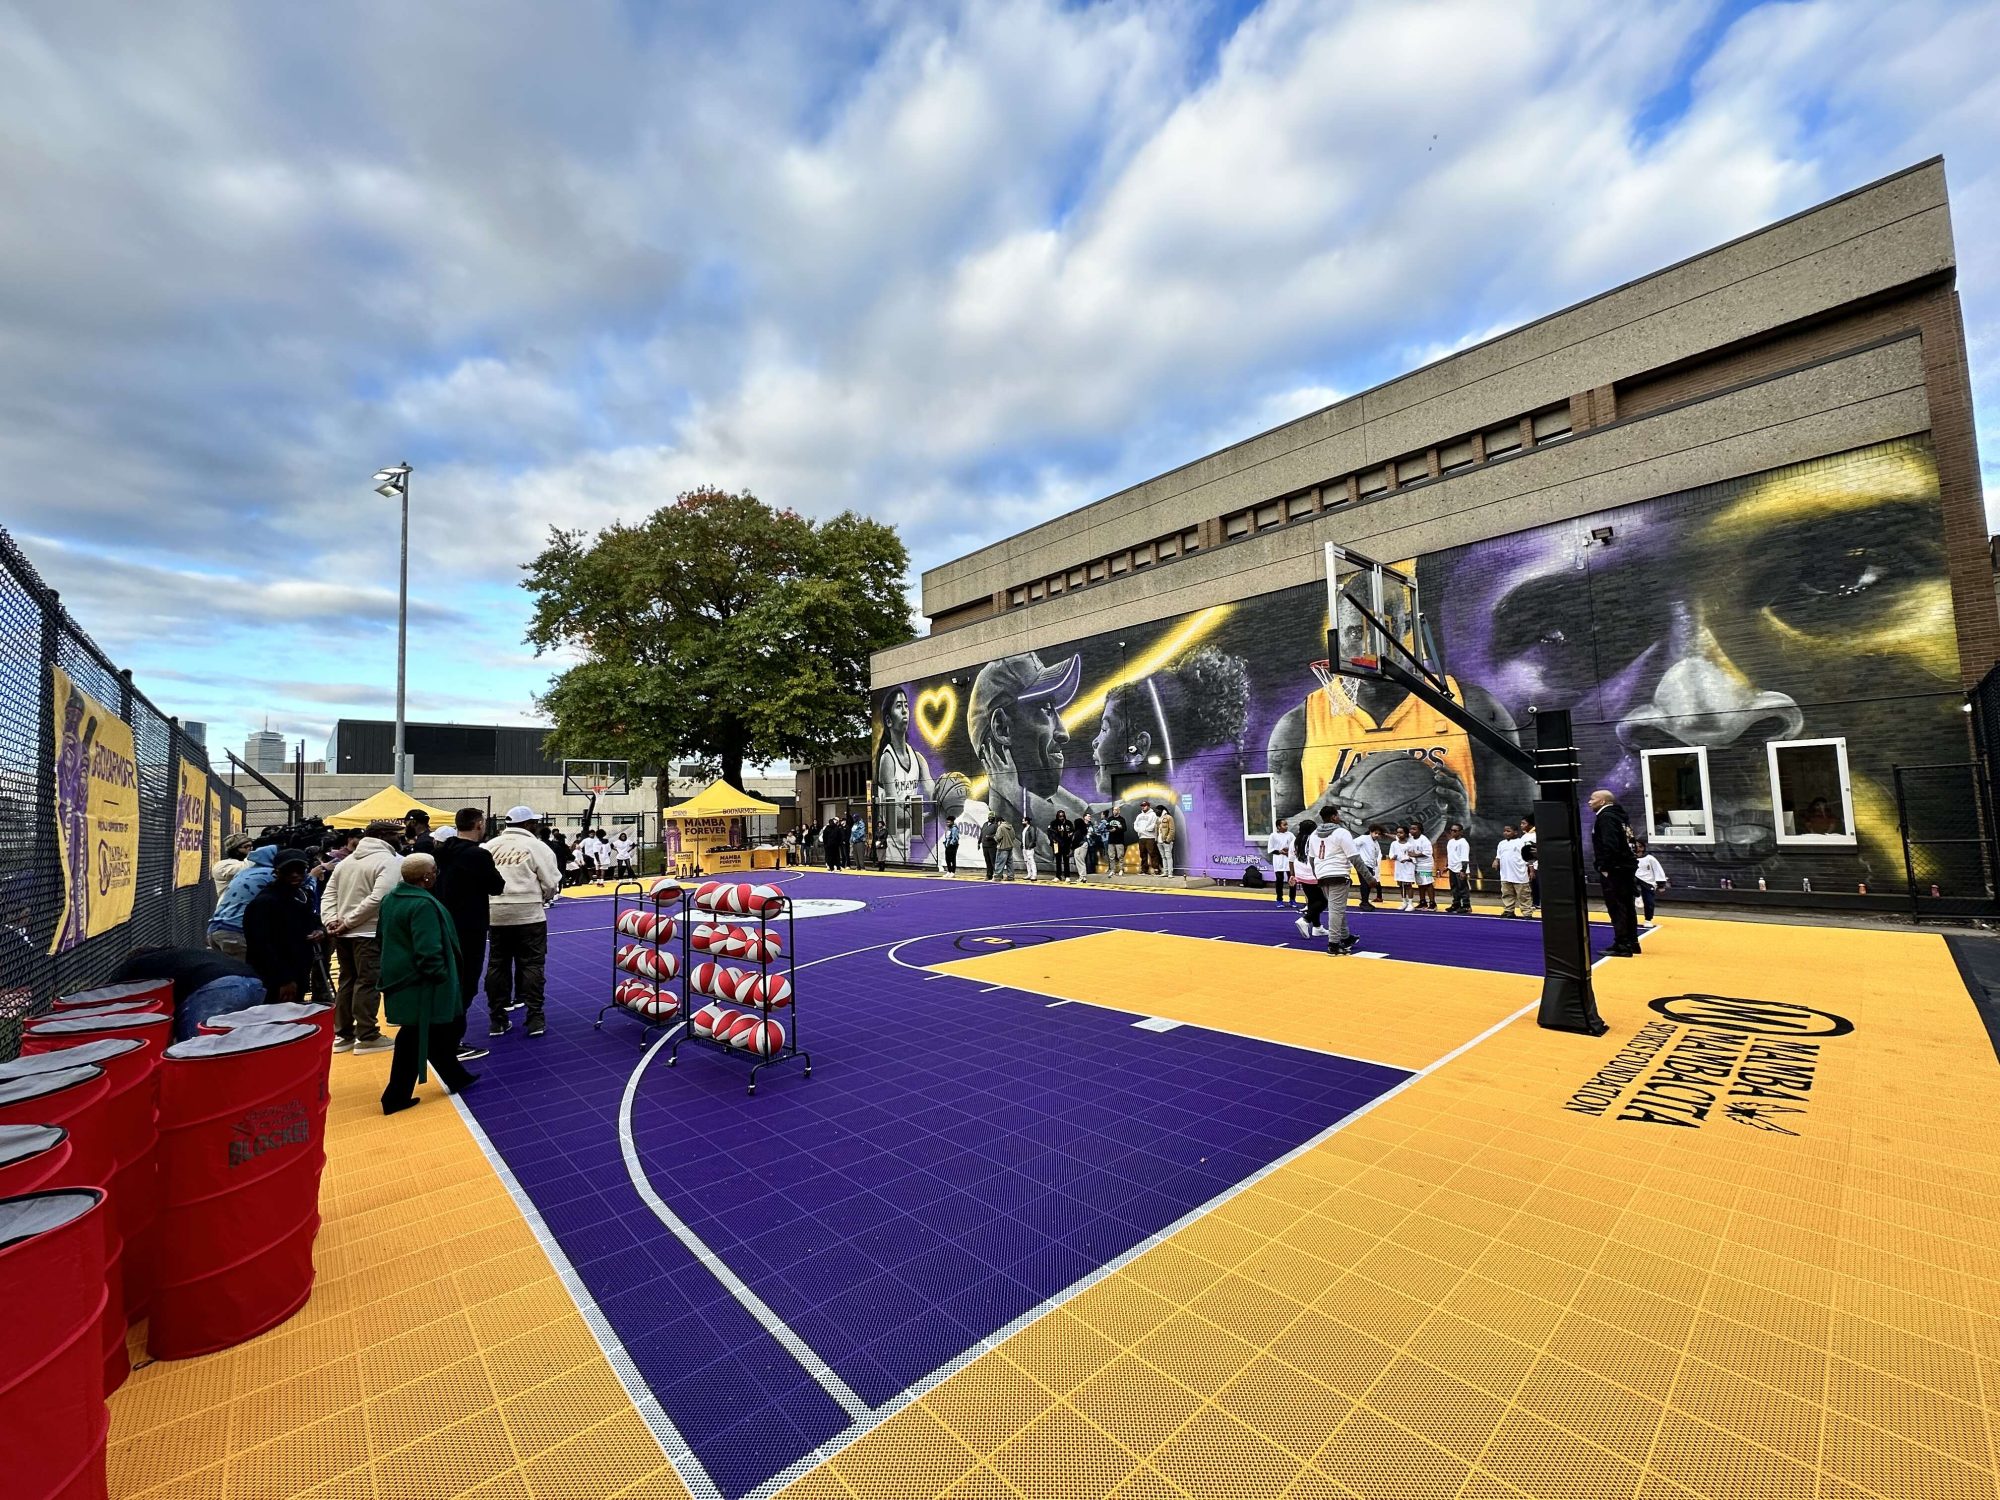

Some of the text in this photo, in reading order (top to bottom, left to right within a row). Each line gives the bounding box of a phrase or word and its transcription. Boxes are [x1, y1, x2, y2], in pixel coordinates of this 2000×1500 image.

[684, 818, 726, 827] MAMBA
[684, 827, 727, 836] FOREVER
[1561, 1021, 1679, 1117] SPORTS FOUNDATION
[1616, 1028, 1750, 1129] MAMBACITA
[1727, 1037, 1821, 1102] MAMBA
[229, 1120, 309, 1168] BLOCKER
